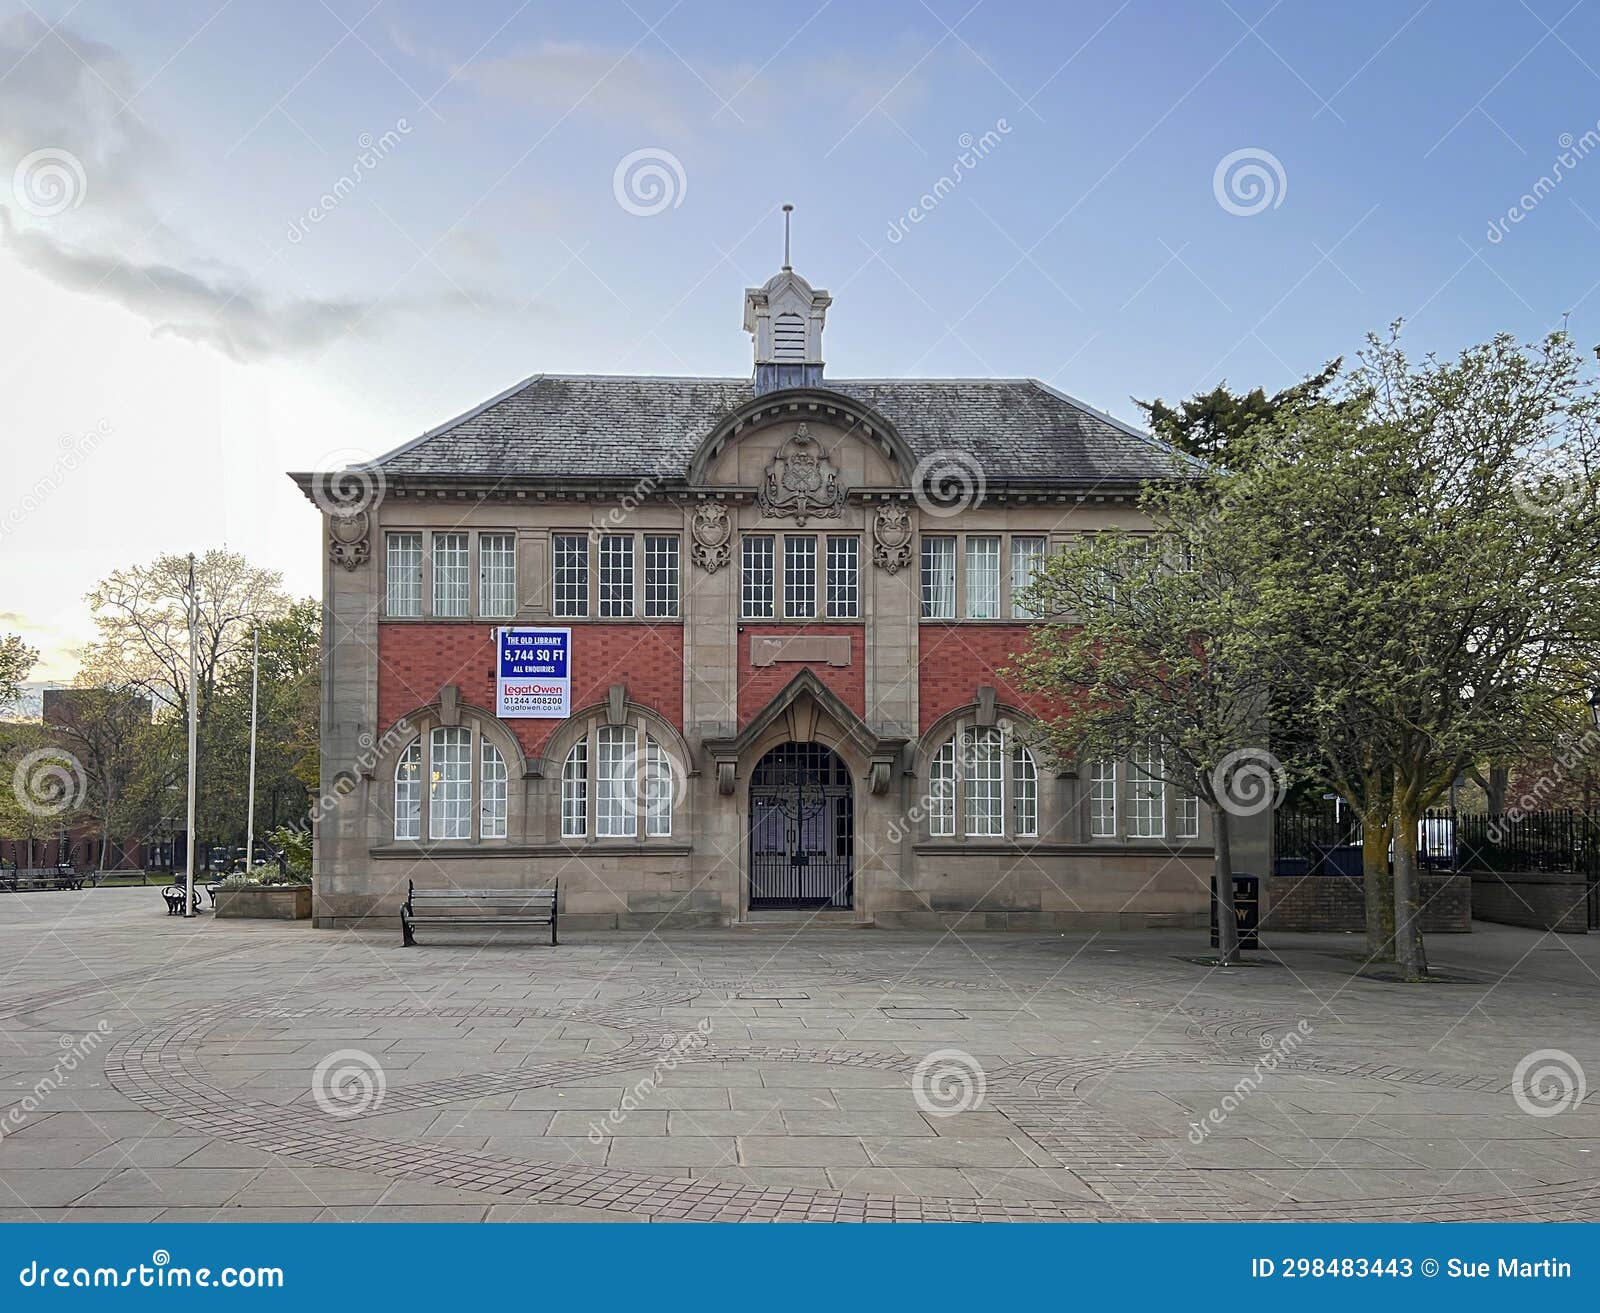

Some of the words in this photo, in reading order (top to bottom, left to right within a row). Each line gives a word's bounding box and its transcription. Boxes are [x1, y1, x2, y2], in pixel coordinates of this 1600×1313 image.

[507, 636, 520, 645] THE
[520, 636, 533, 645] OLD
[534, 637, 562, 645] LIBRARY
[504, 649, 534, 662] 5,744
[536, 649, 550, 662] SQ
[553, 650, 565, 661] FT
[512, 665, 523, 673] ALL
[525, 665, 556, 673] ENQUIRIES
